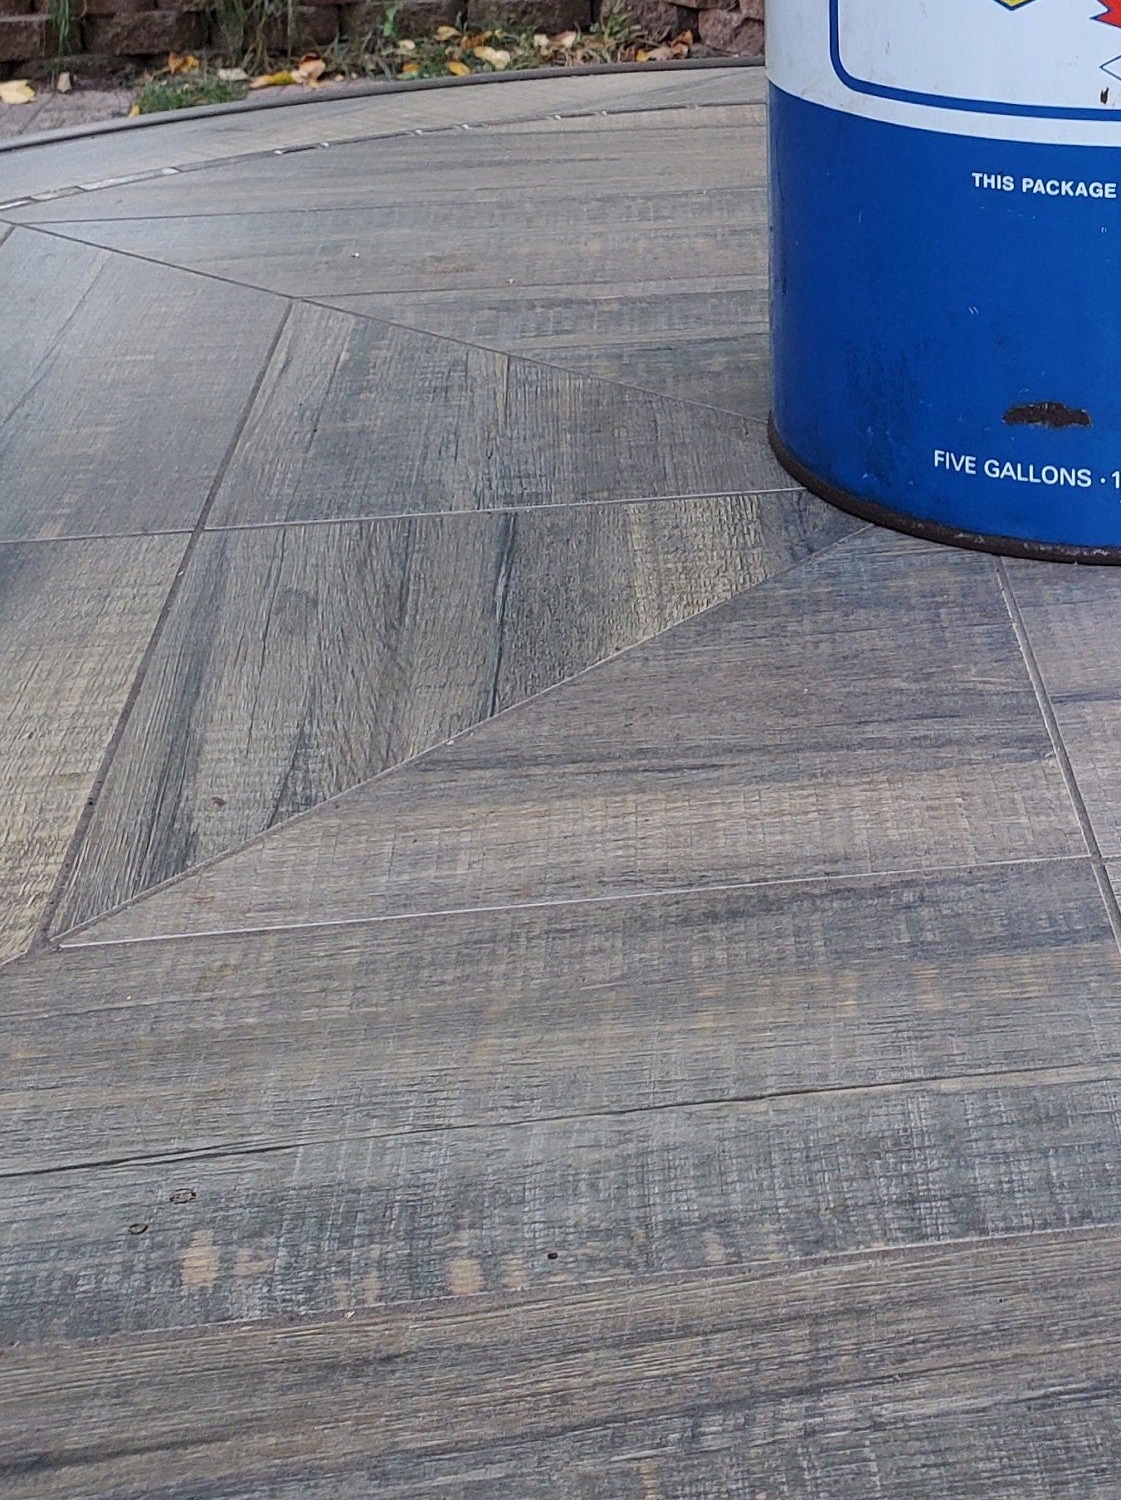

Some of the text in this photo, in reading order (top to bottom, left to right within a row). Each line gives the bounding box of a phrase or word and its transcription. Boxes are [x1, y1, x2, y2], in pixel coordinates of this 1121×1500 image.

[971, 172, 1015, 191] THIS
[1022, 177, 1117, 199] PACKAGE
[934, 449, 976, 475] FIVE
[984, 459, 1092, 488] GALLONS
